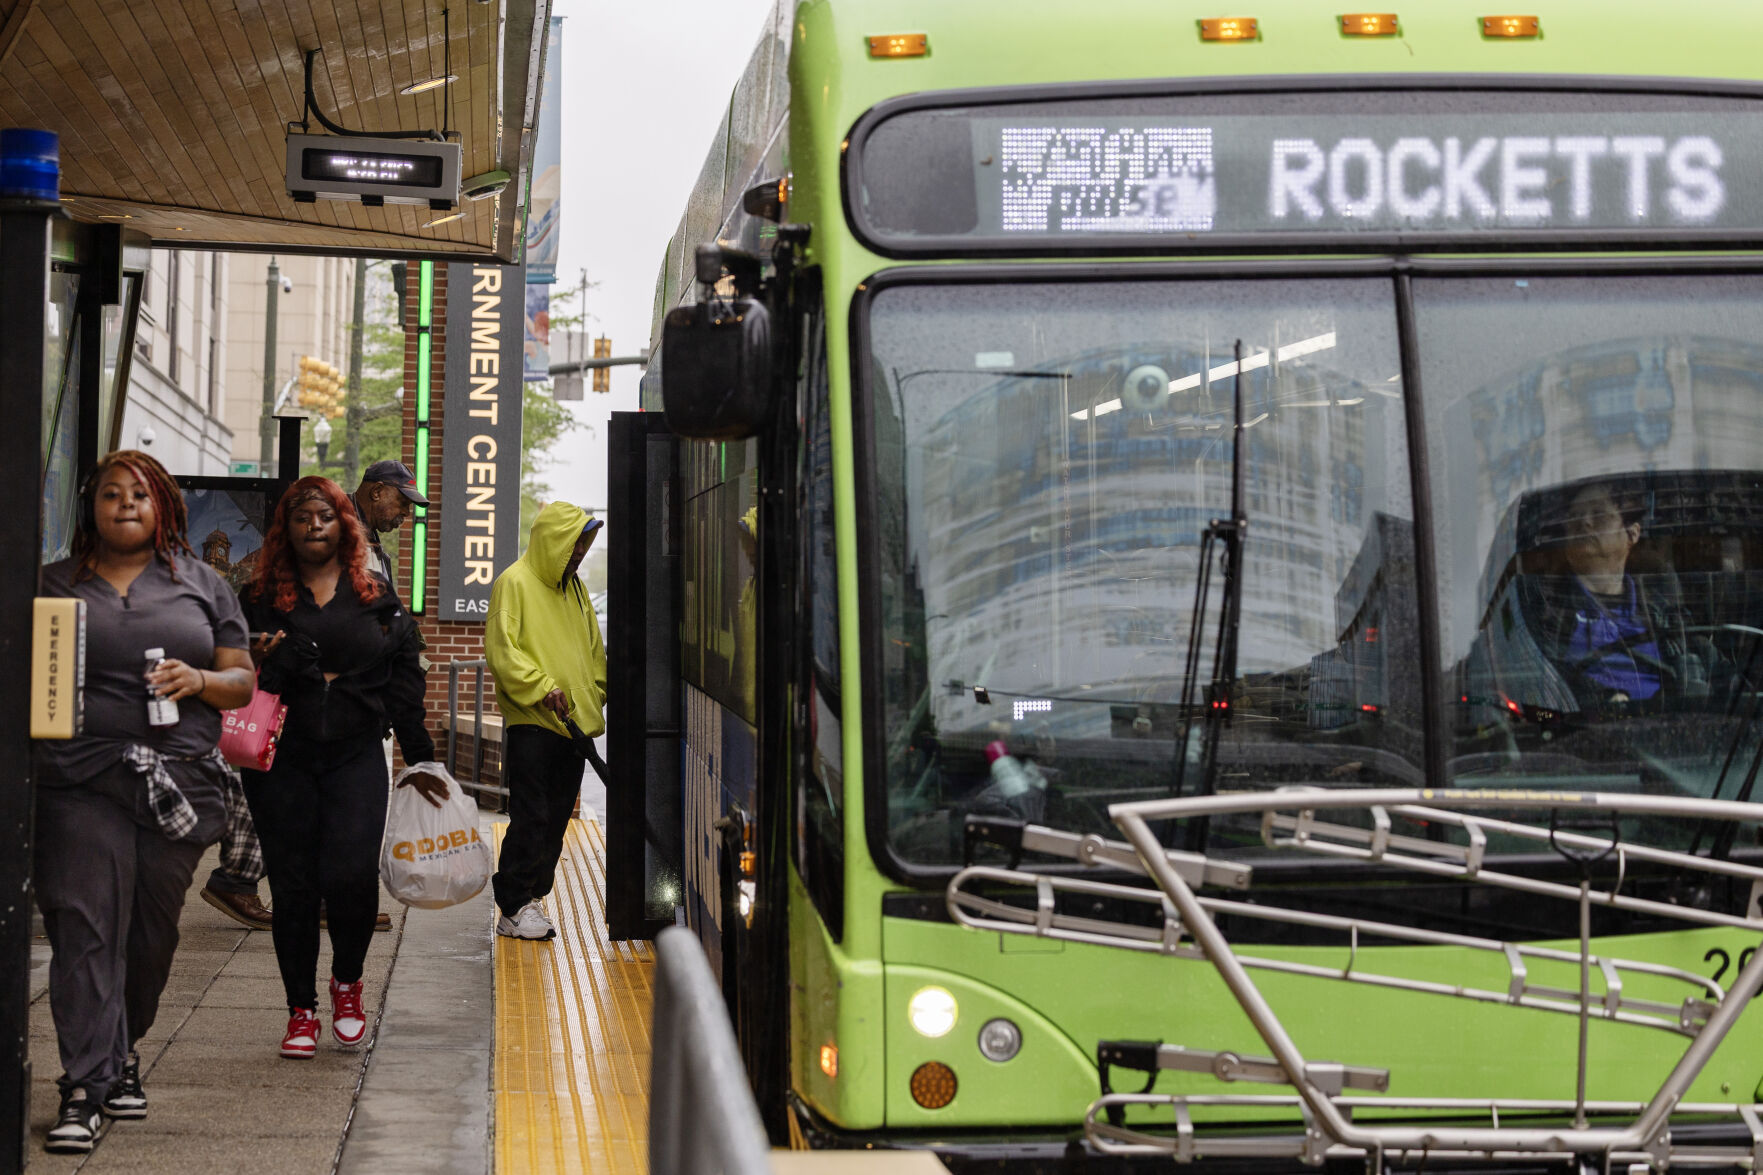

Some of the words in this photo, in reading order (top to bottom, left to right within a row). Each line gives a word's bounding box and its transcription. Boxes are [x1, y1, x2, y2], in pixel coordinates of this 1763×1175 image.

[1271, 136, 1725, 218] ROCKETTS
[469, 263, 502, 425] RNMENT
[464, 434, 498, 586] CENTER
[455, 599, 489, 613] EAS
[47, 615, 59, 722] EMERGENCY
[226, 716, 257, 733] BAG
[392, 827, 482, 862] QDOBA
